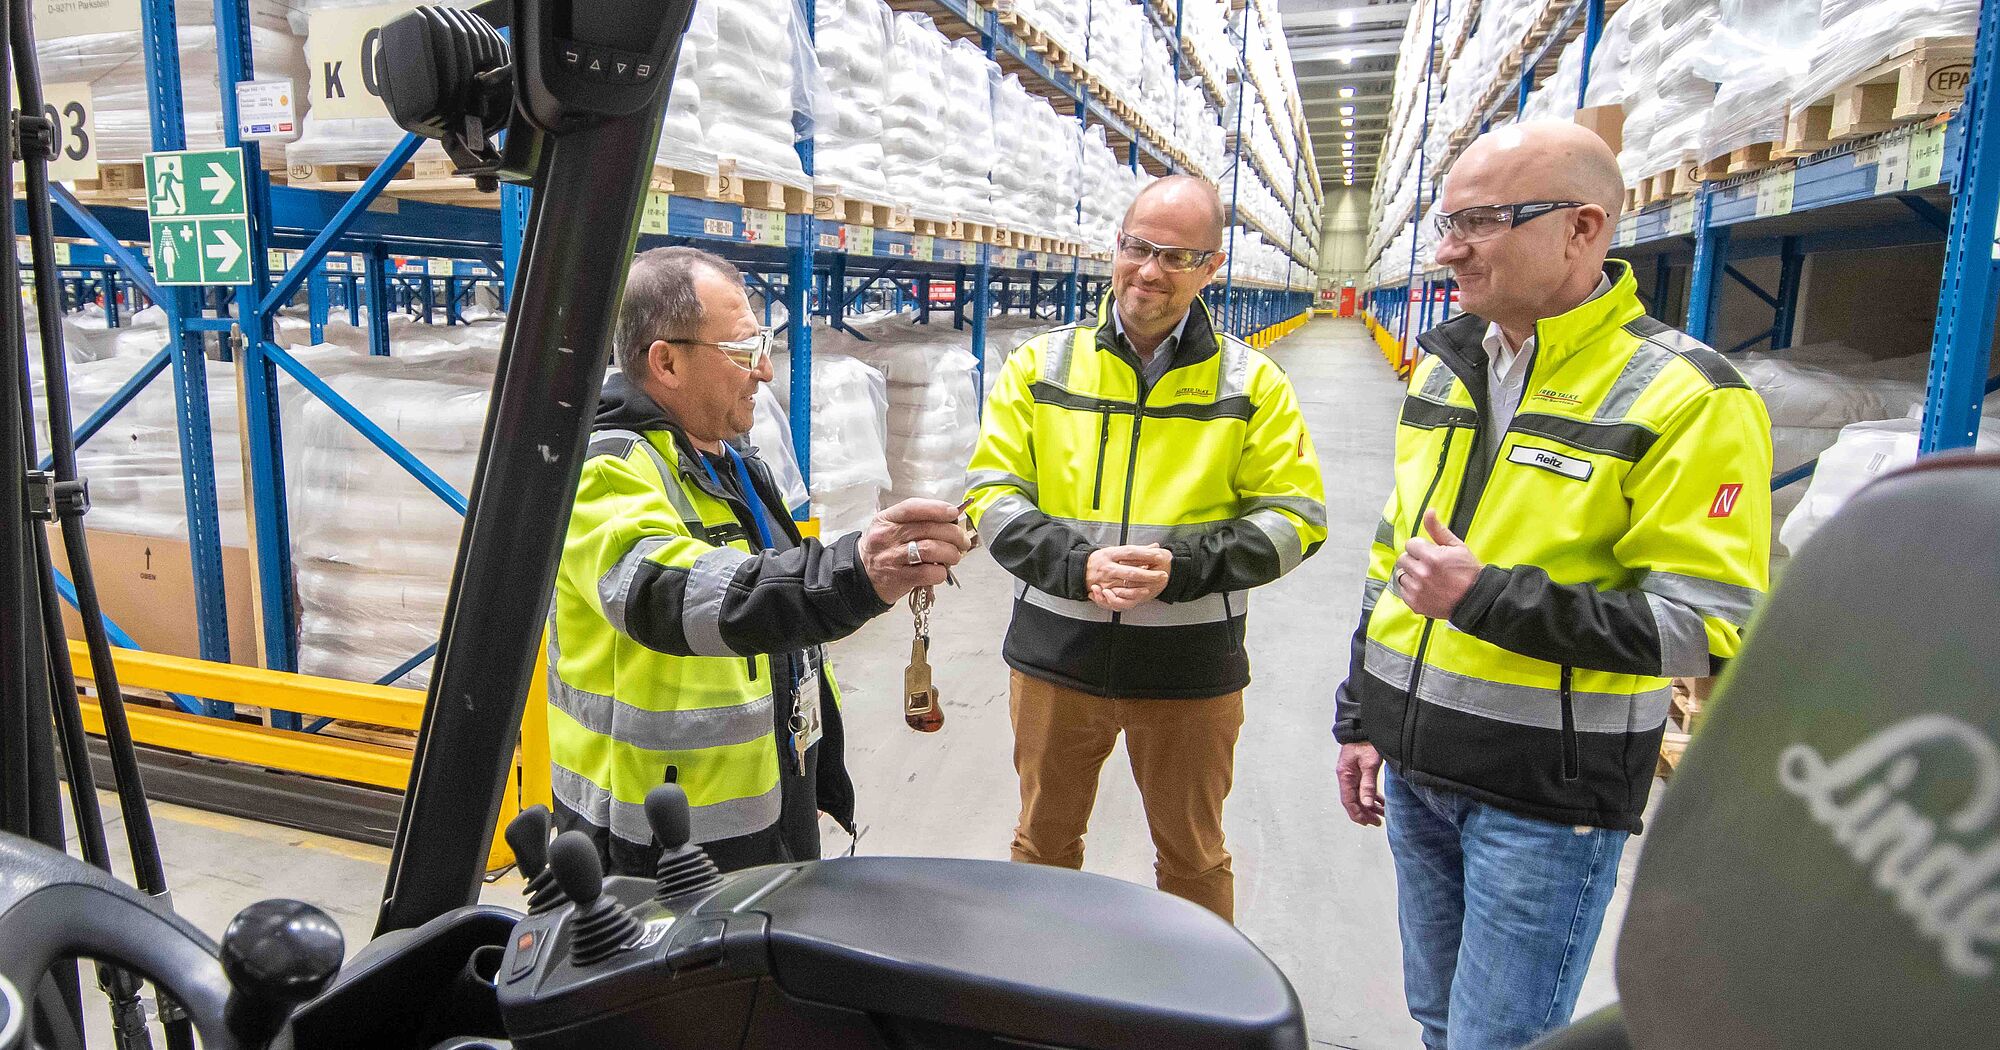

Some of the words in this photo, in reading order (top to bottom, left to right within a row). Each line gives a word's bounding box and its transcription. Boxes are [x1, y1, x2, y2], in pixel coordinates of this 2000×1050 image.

[324, 61, 345, 98] K
[1937, 71, 1970, 91] EPA
[1535, 453, 1563, 468] Reitz
